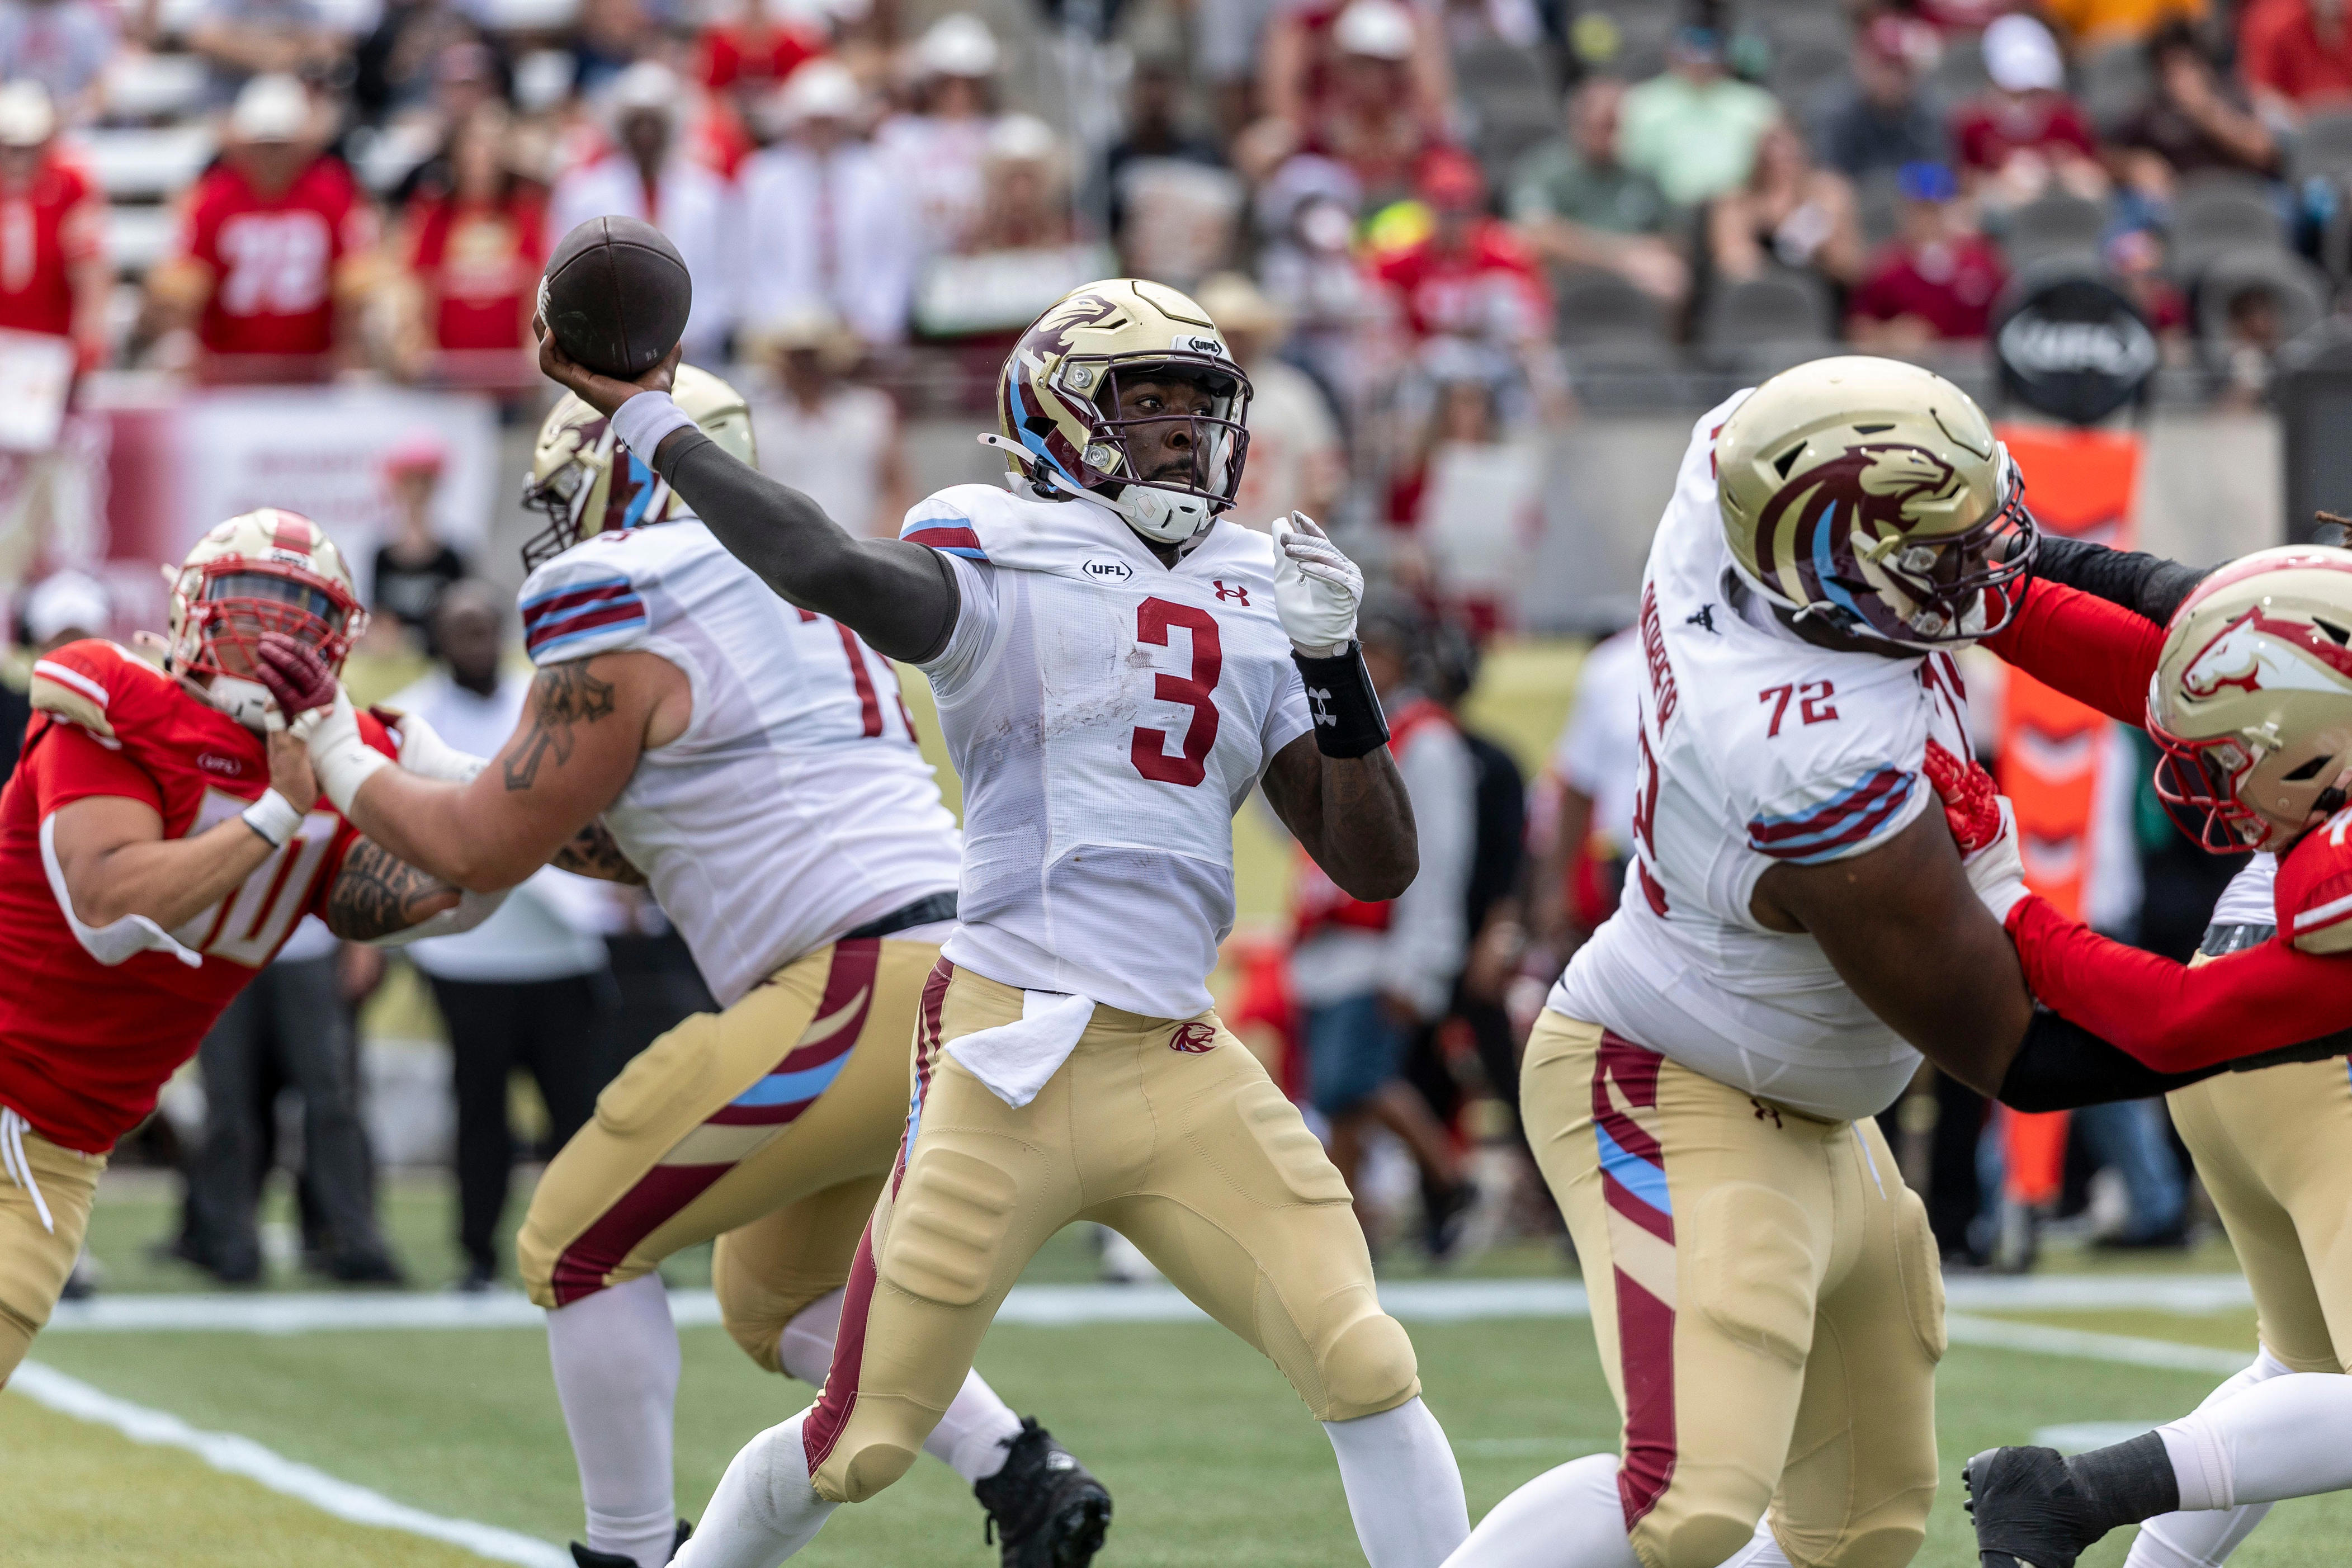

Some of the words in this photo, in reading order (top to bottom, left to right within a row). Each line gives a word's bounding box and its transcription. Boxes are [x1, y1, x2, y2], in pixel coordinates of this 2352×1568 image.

[1091, 564, 1126, 576] UFL
[1130, 596, 1222, 788] 3
[1759, 679, 1839, 739] 72
